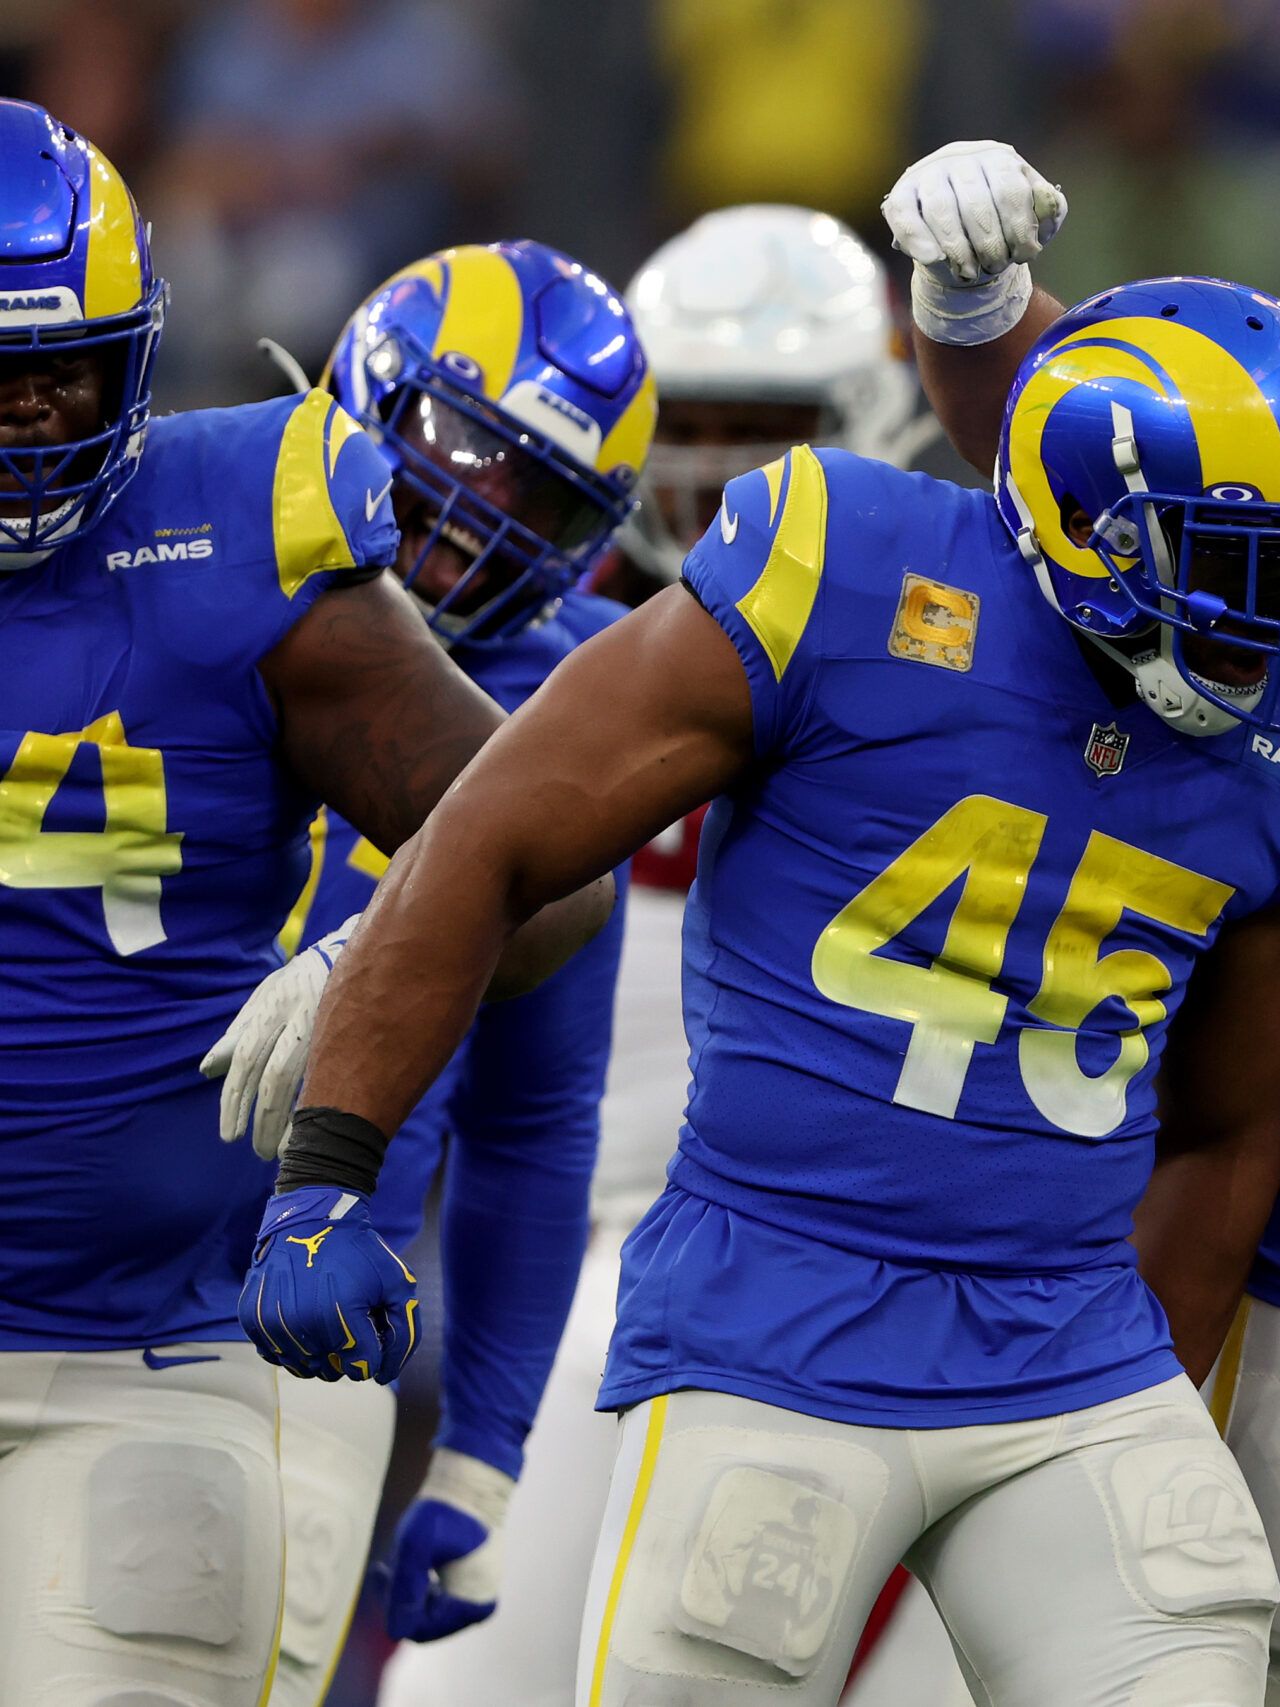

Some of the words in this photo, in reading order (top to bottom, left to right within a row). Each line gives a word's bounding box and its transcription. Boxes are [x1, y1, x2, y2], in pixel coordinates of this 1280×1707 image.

[106, 538, 213, 572] RAMS
[903, 585, 973, 647] C
[1090, 742, 1120, 769] NFL
[0, 709, 185, 957] 4
[811, 794, 1236, 1138] 45
[752, 1552, 800, 1598] 24
